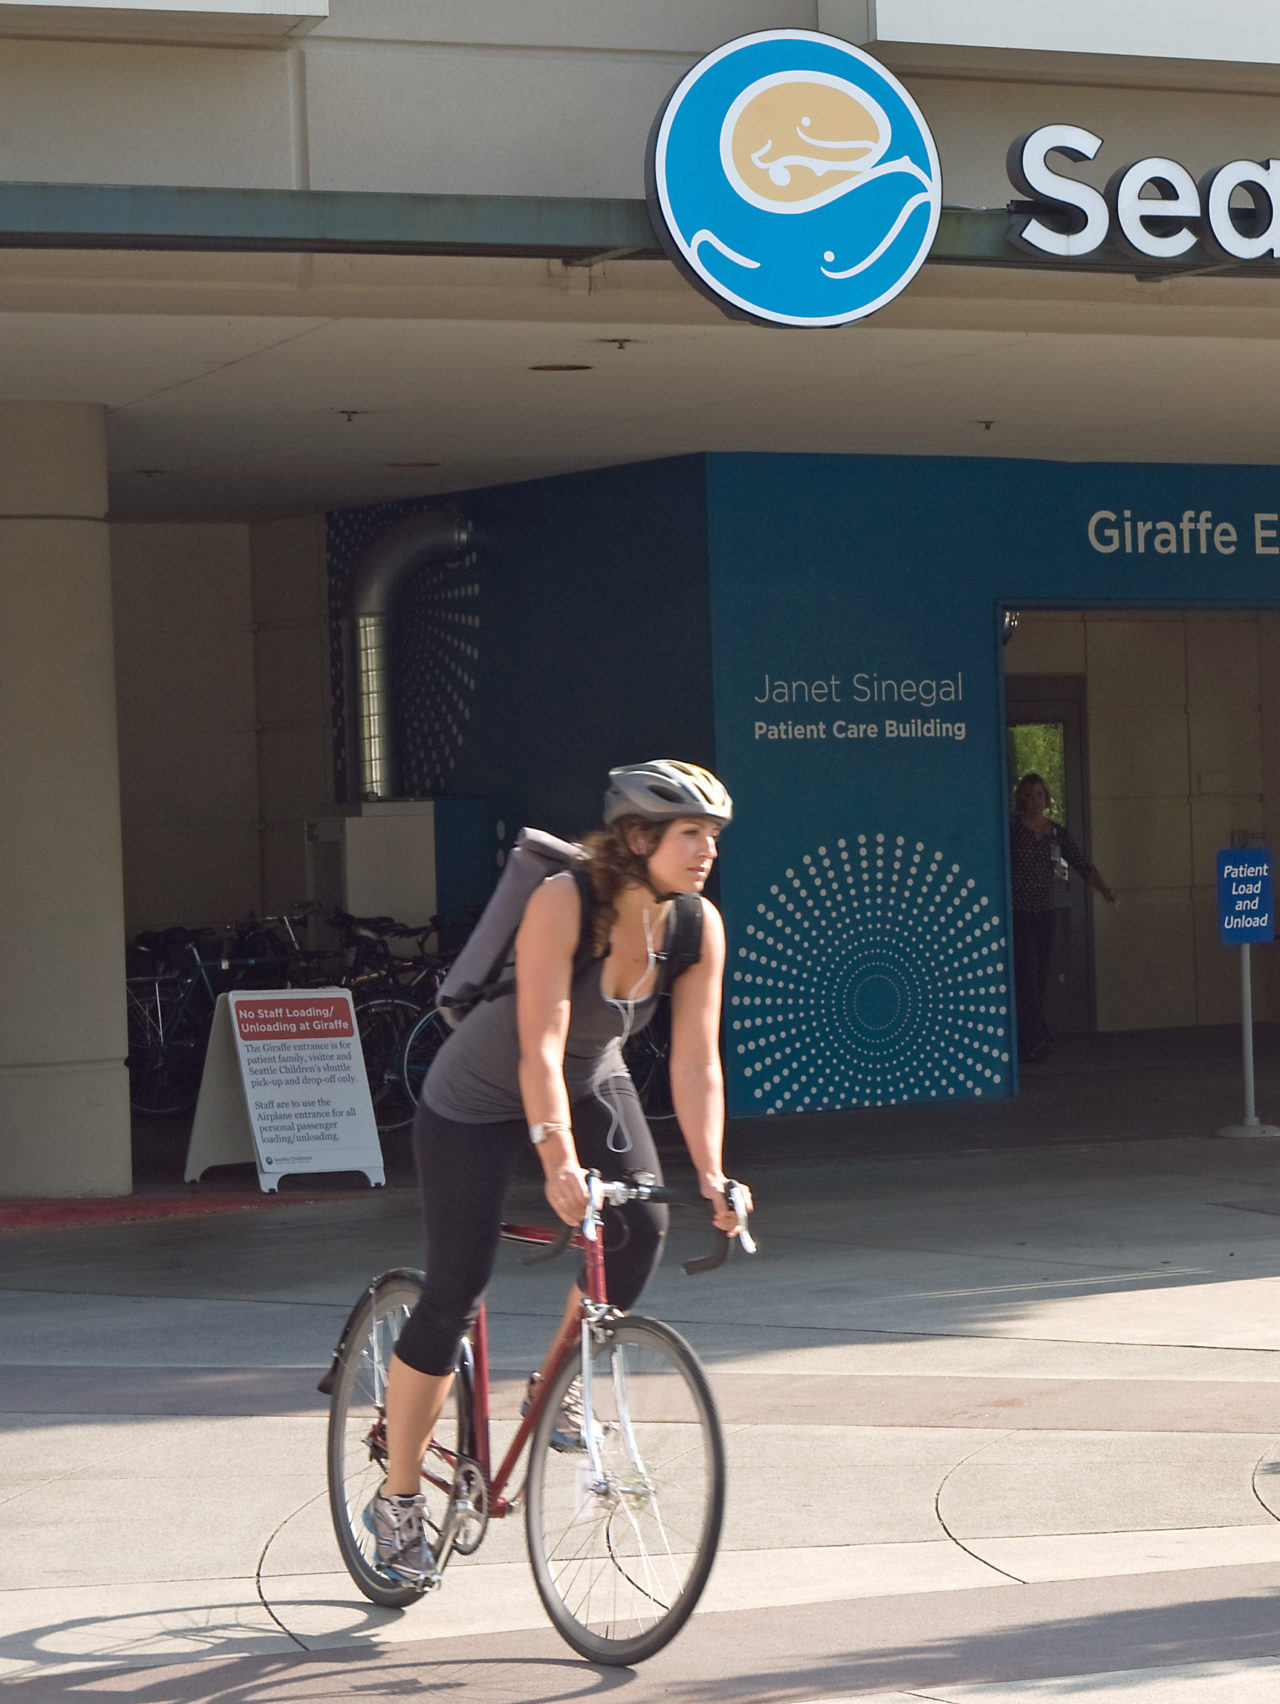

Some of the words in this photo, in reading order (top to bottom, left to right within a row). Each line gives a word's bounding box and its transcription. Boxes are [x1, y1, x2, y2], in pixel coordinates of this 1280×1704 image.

[1088, 510, 1238, 554] Giraffe
[754, 674, 841, 703] Janet
[853, 672, 963, 707] Sinegal
[754, 721, 827, 739] Patient
[833, 720, 879, 738] Care
[885, 719, 966, 740] Building
[1224, 864, 1269, 878] Patient
[1232, 880, 1262, 895] Load
[1235, 896, 1260, 910] and
[1224, 913, 1269, 929] Unload
[239, 1009, 255, 1019] No
[257, 1008, 283, 1018] Staff
[286, 1006, 334, 1018] Loading/
[241, 1022, 297, 1032] Unloading
[300, 1022, 310, 1030] at
[313, 1020, 349, 1030] Giraffe
[244, 1044, 261, 1053] The
[262, 1042, 292, 1052] Giraffe
[293, 1042, 330, 1051] entrance
[331, 1041, 338, 1049] is
[339, 1040, 351, 1049] for
[247, 1056, 277, 1065] patient
[279, 1054, 307, 1064] family,
[308, 1053, 334, 1061] visitor
[336, 1052, 352, 1061] and
[248, 1066, 277, 1075] Seattle
[279, 1064, 322, 1074] Children's
[323, 1063, 351, 1072] shuttle
[251, 1078, 283, 1088] pick-up
[284, 1076, 300, 1085] and
[302, 1074, 336, 1085] drop-off
[337, 1074, 358, 1085] only.
[254, 1100, 274, 1110] Staff
[276, 1101, 290, 1109] are
[291, 1100, 300, 1108] to
[301, 1100, 316, 1108] use
[317, 1097, 331, 1107] the
[257, 1111, 293, 1122] Airplane
[294, 1110, 331, 1119] entrance
[331, 1108, 344, 1117] for
[346, 1107, 356, 1117] all
[259, 1122, 295, 1134] personal
[296, 1121, 338, 1132] passenger
[261, 1131, 340, 1144] loading/unloading.
